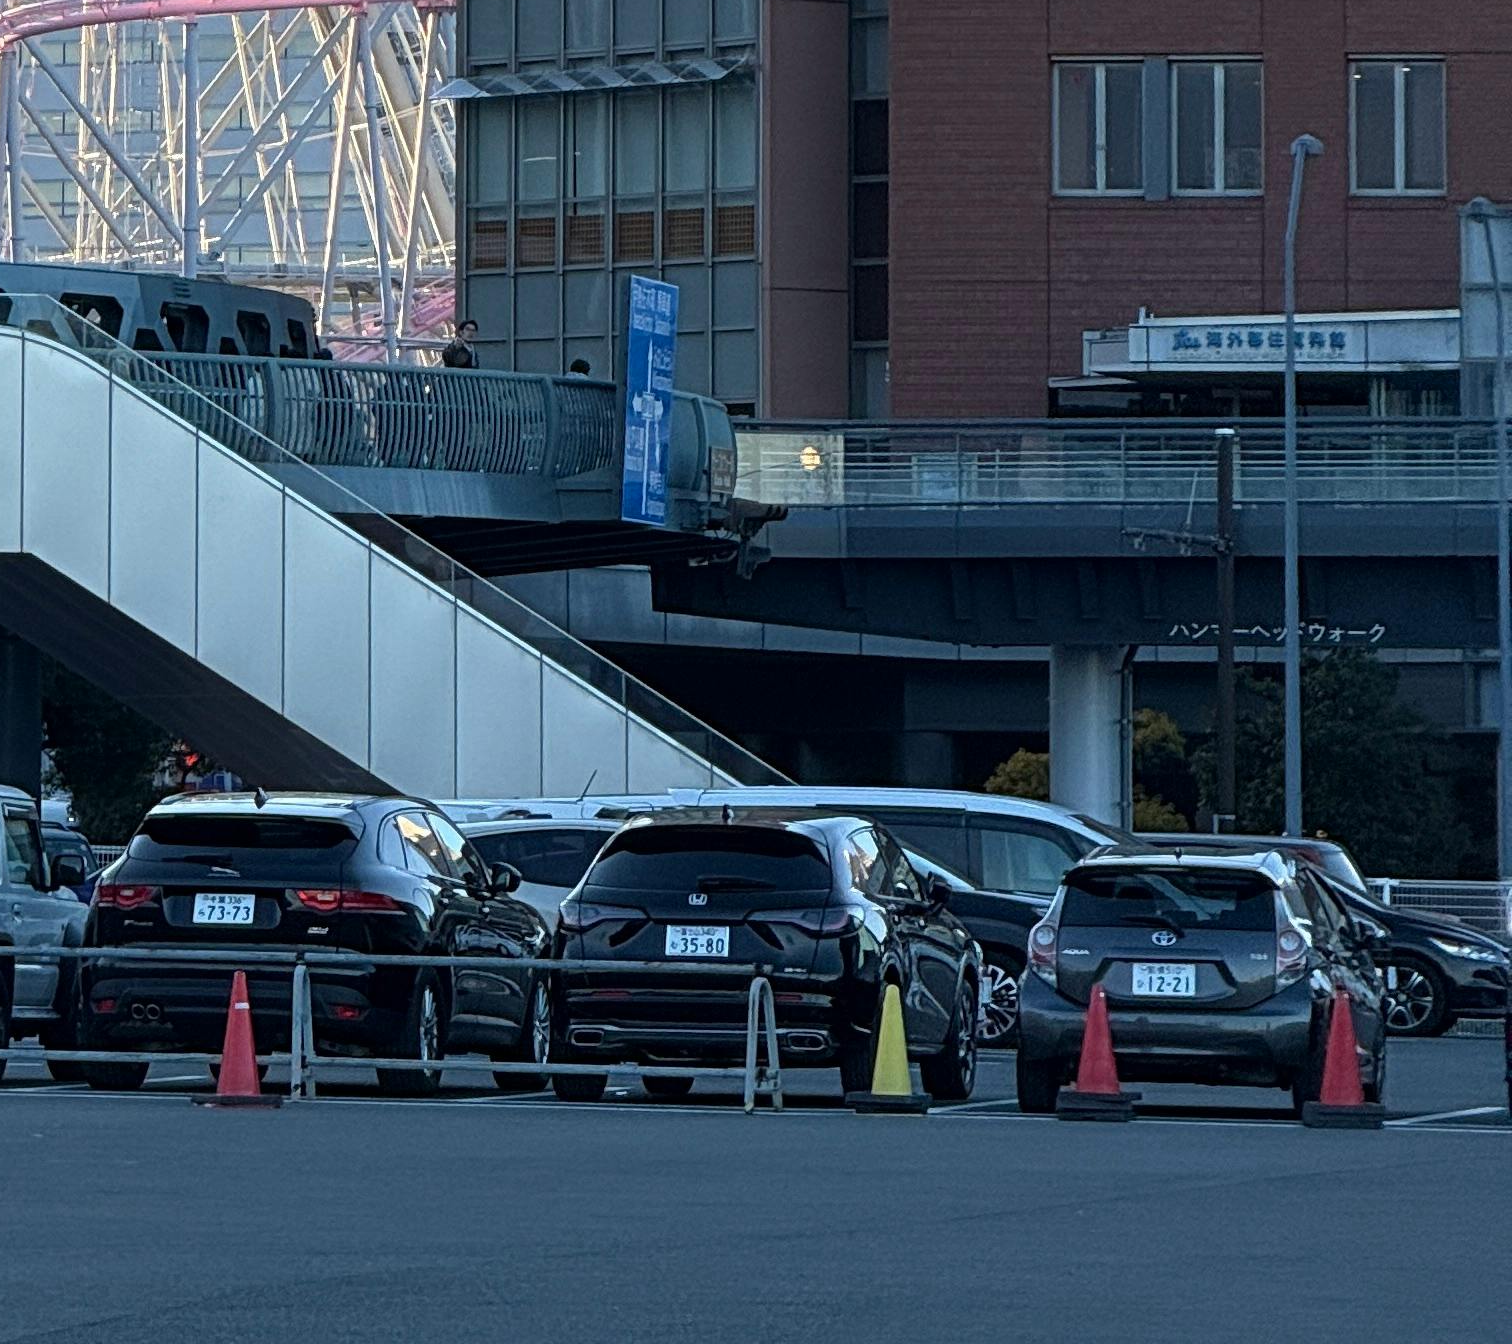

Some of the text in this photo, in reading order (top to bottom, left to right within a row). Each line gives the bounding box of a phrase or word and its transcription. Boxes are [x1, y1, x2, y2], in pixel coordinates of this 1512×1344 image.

[207, 904, 251, 921] 73-73
[680, 937, 725, 954] 35-80
[1148, 975, 1190, 993] 12-21
